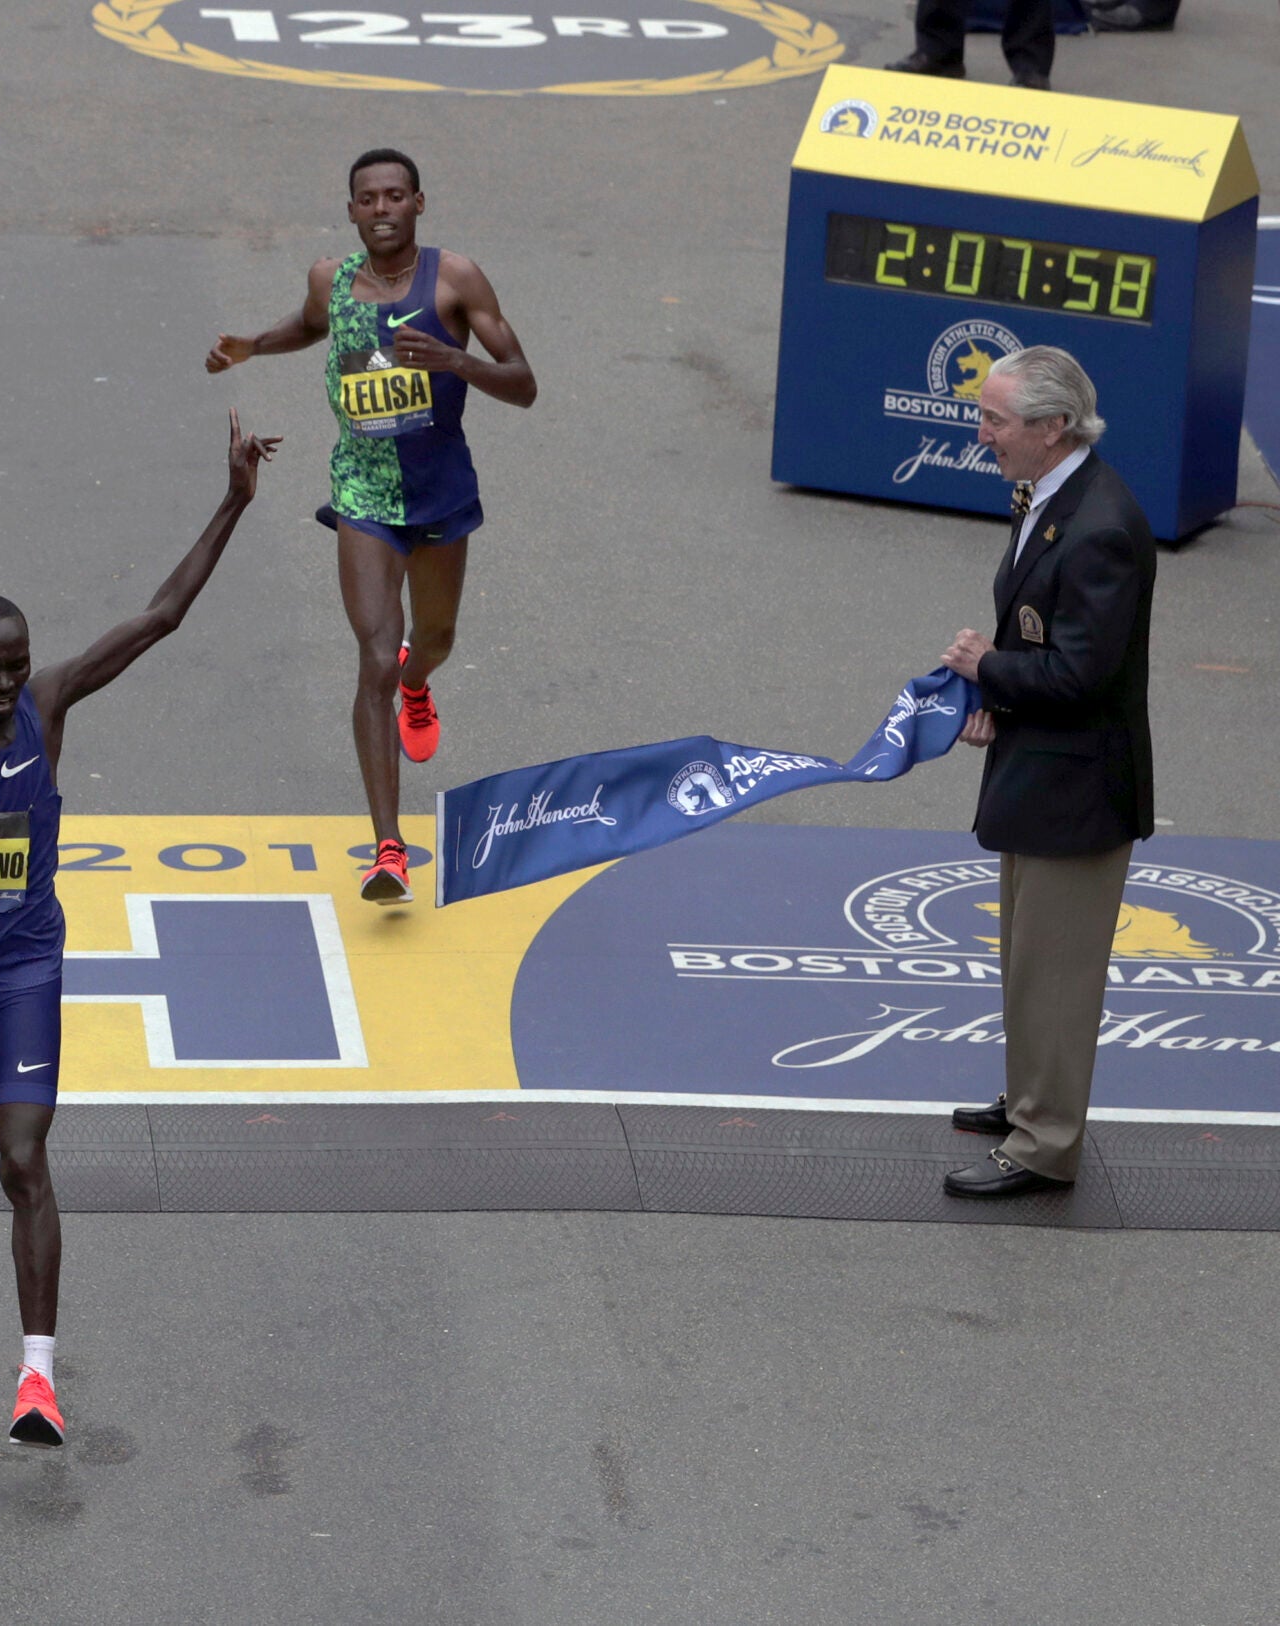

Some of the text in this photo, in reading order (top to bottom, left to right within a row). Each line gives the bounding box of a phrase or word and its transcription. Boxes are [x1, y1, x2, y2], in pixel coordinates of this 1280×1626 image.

[879, 125, 1048, 161] MARATHON
[886, 106, 941, 127] 2019
[945, 113, 1051, 142] BOSTON
[875, 223, 1152, 319] 2:07:58
[931, 324, 995, 390] BOSTON ATHLETIC
[343, 372, 428, 416] LELISA
[884, 394, 959, 420] BOSTON
[892, 435, 954, 484] John
[472, 784, 618, 869] John Hancock
[864, 887, 930, 943] BOSTON
[898, 865, 1000, 890] ATHL
